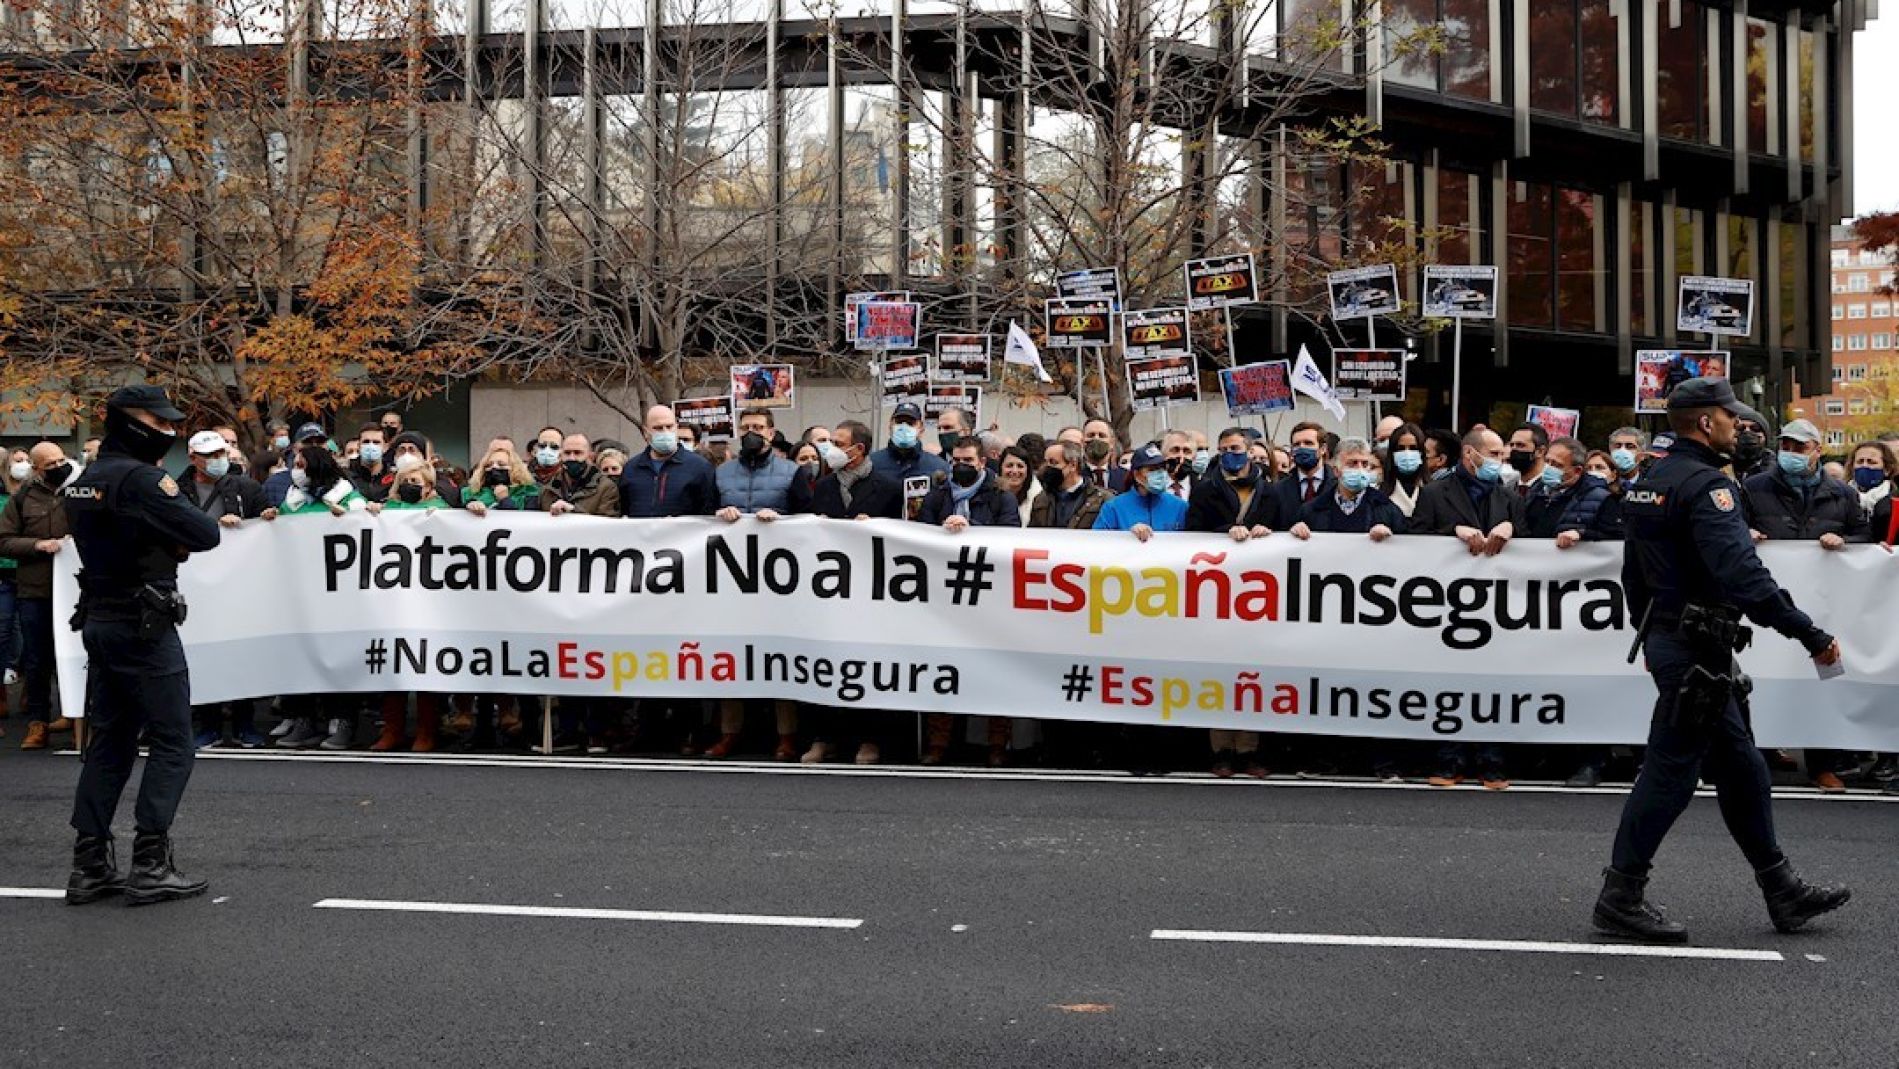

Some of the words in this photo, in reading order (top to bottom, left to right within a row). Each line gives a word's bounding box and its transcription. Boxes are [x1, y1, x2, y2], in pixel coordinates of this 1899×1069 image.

[323, 528, 685, 593] Plataforma
[706, 534, 799, 595] No
[811, 549, 852, 599] a
[871, 536, 928, 602] la
[365, 637, 960, 701] #NoaLaEspañaInsegura
[1061, 664, 1566, 735] #EspañaInsegura
